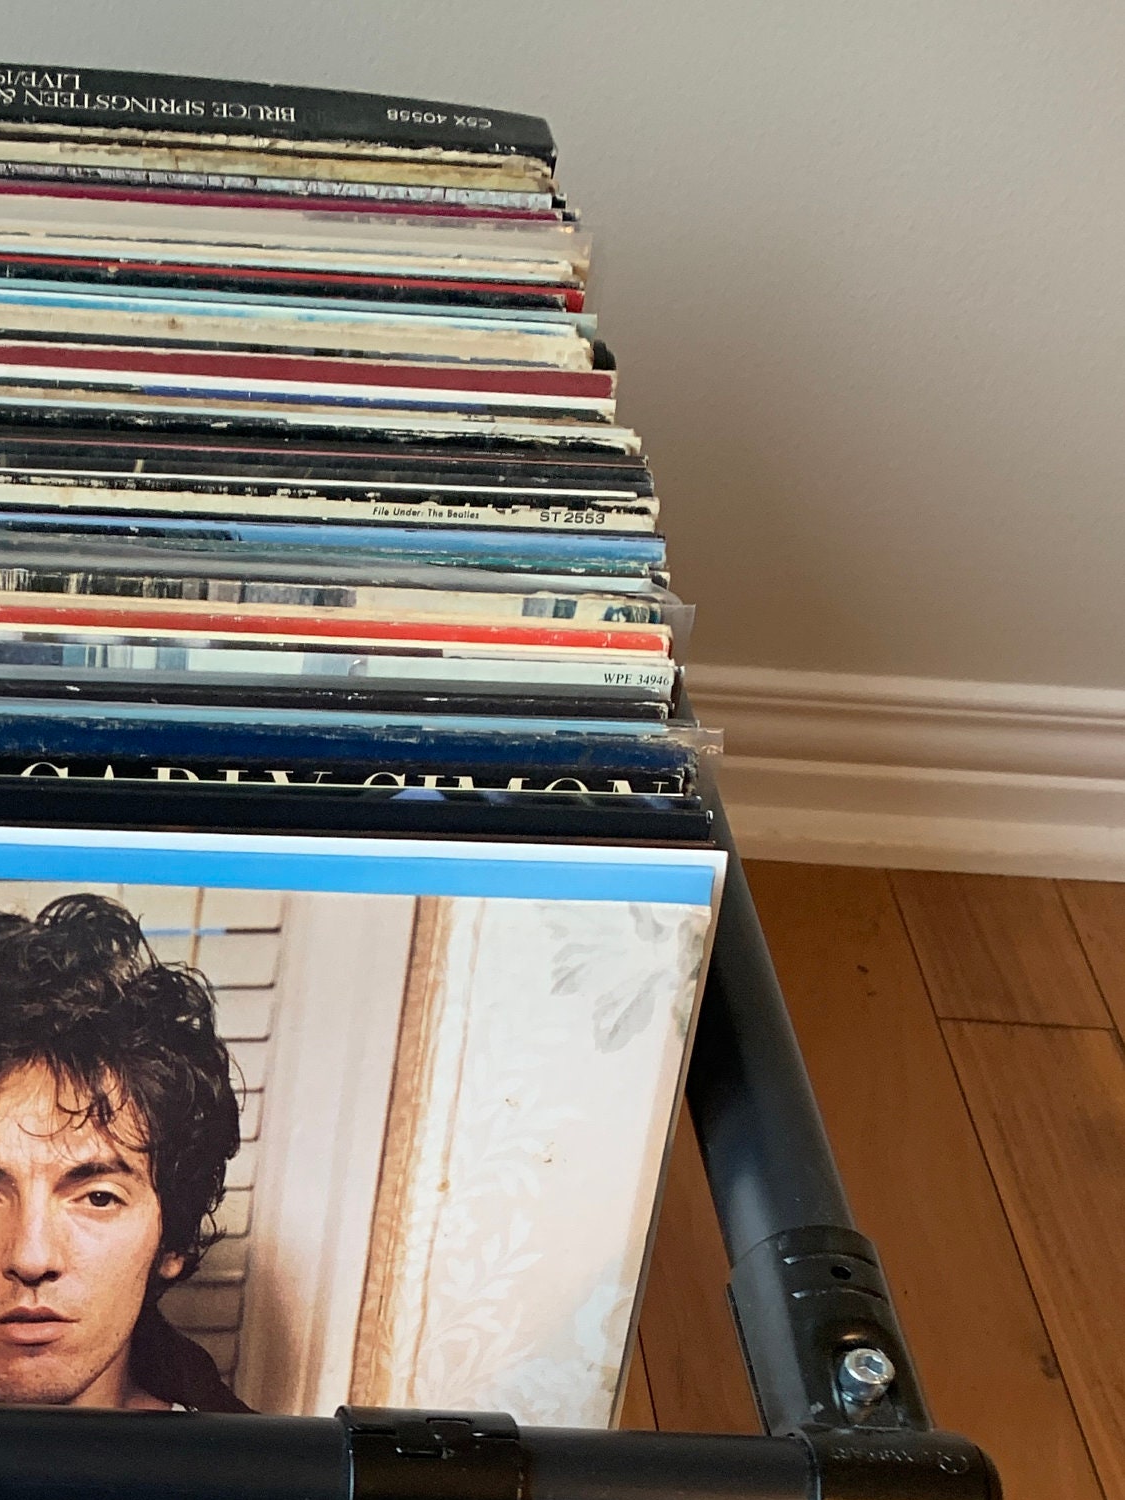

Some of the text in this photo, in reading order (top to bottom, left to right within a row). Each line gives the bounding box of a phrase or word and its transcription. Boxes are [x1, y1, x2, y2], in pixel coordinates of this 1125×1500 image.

[25, 90, 205, 117] SPRINGSTEEN
[213, 101, 296, 123] BRUCE
[373, 508, 391, 517] File
[427, 508, 444, 518] The
[447, 509, 480, 519] Beatles
[539, 511, 606, 524] ST 2553
[603, 673, 633, 685] WPE
